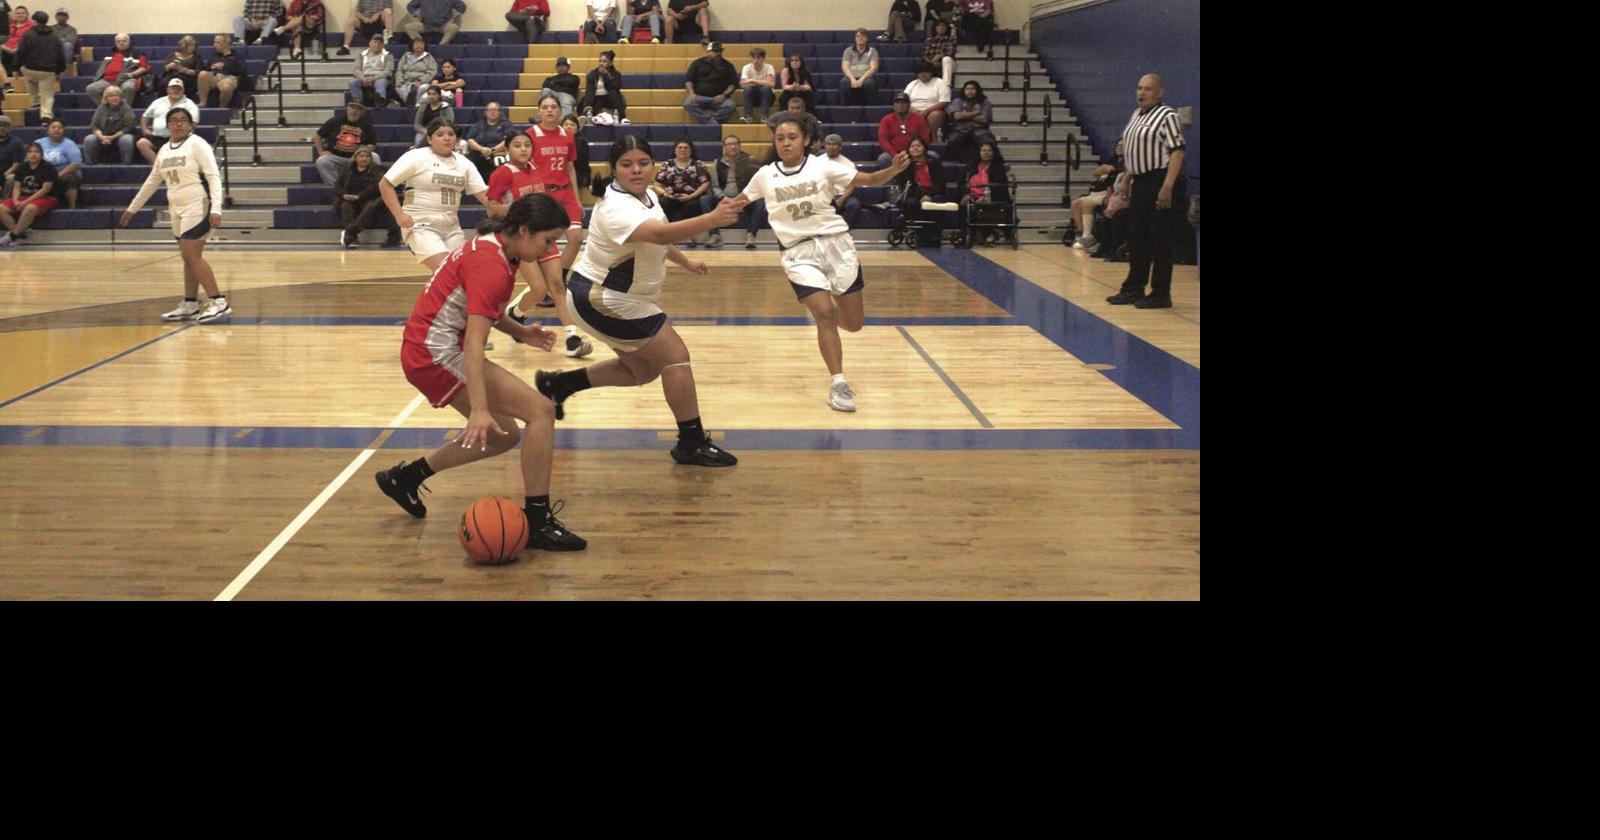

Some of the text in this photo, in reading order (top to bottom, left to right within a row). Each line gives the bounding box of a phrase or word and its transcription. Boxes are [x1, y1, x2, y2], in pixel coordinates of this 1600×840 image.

[550, 157, 564, 170] 22
[167, 169, 180, 184] 14
[432, 173, 465, 187] PARKER
[441, 187, 455, 204] 11
